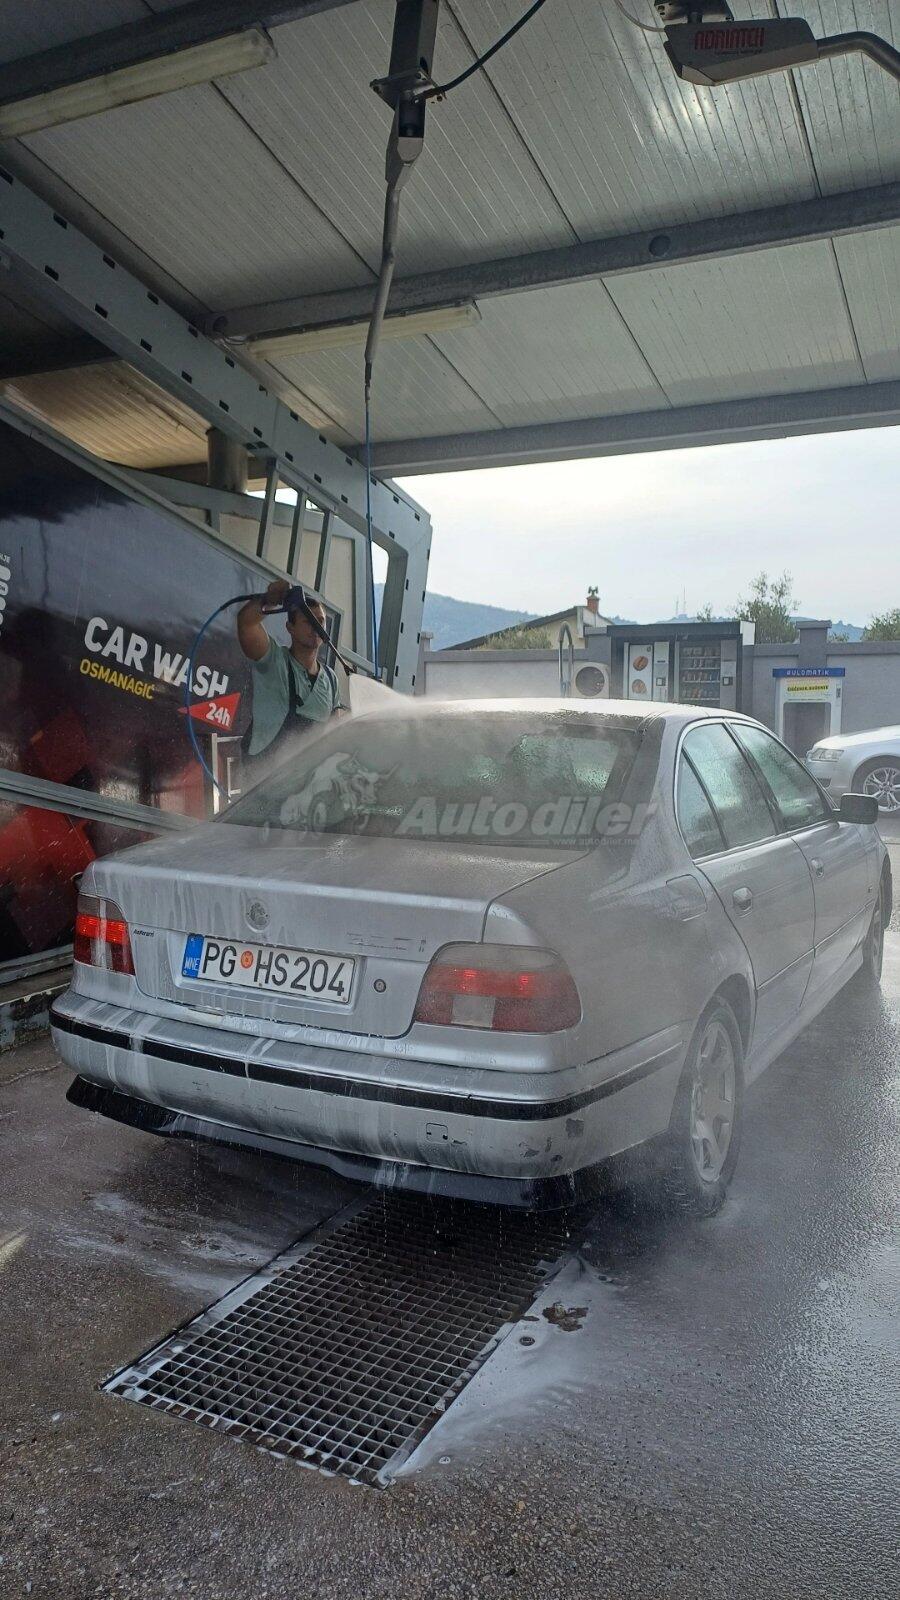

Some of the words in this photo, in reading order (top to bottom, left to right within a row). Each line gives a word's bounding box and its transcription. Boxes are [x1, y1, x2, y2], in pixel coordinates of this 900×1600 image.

[84, 616, 147, 672] CAR
[153, 642, 229, 698] WASH
[205, 702, 231, 726] 24h
[185, 956, 201, 972] MNE
[203, 942, 237, 977] PG
[254, 949, 345, 997] HS204
